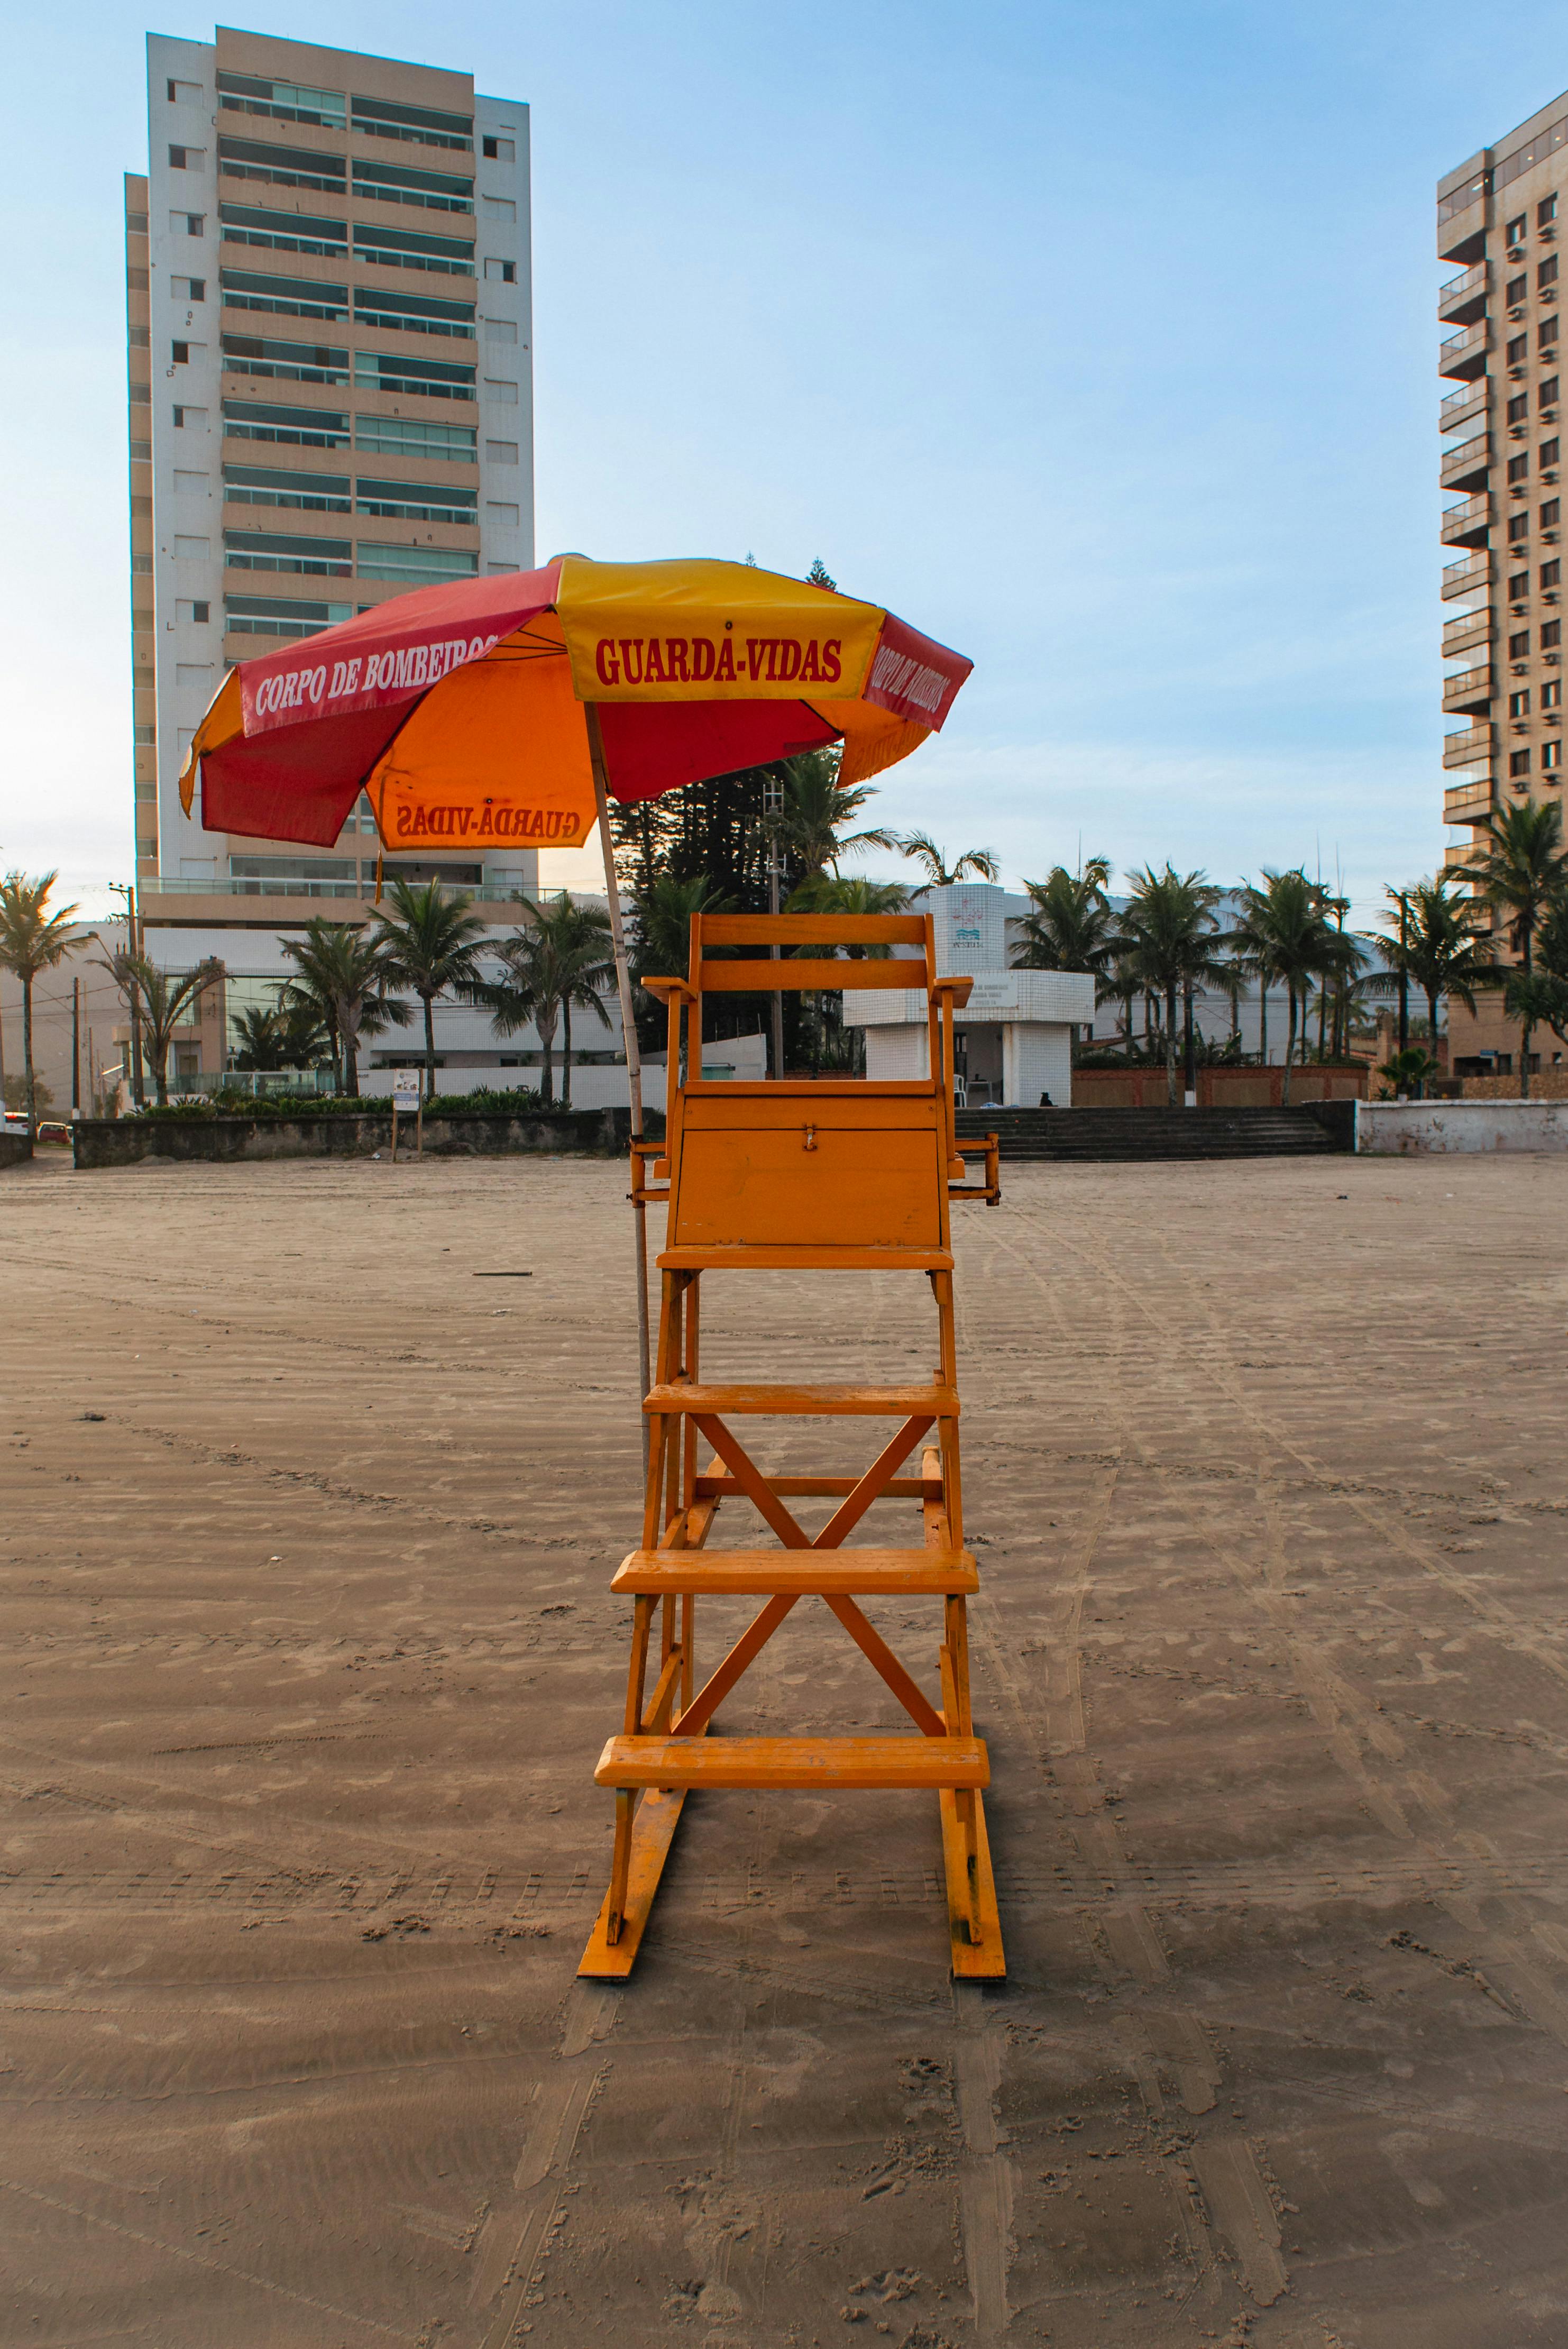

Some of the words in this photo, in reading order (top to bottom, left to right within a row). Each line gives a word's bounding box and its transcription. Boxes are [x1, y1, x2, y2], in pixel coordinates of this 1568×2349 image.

[256, 665, 326, 716] CORPO
[328, 657, 362, 699] DE
[595, 638, 842, 686] GUARDA-VIDAS
